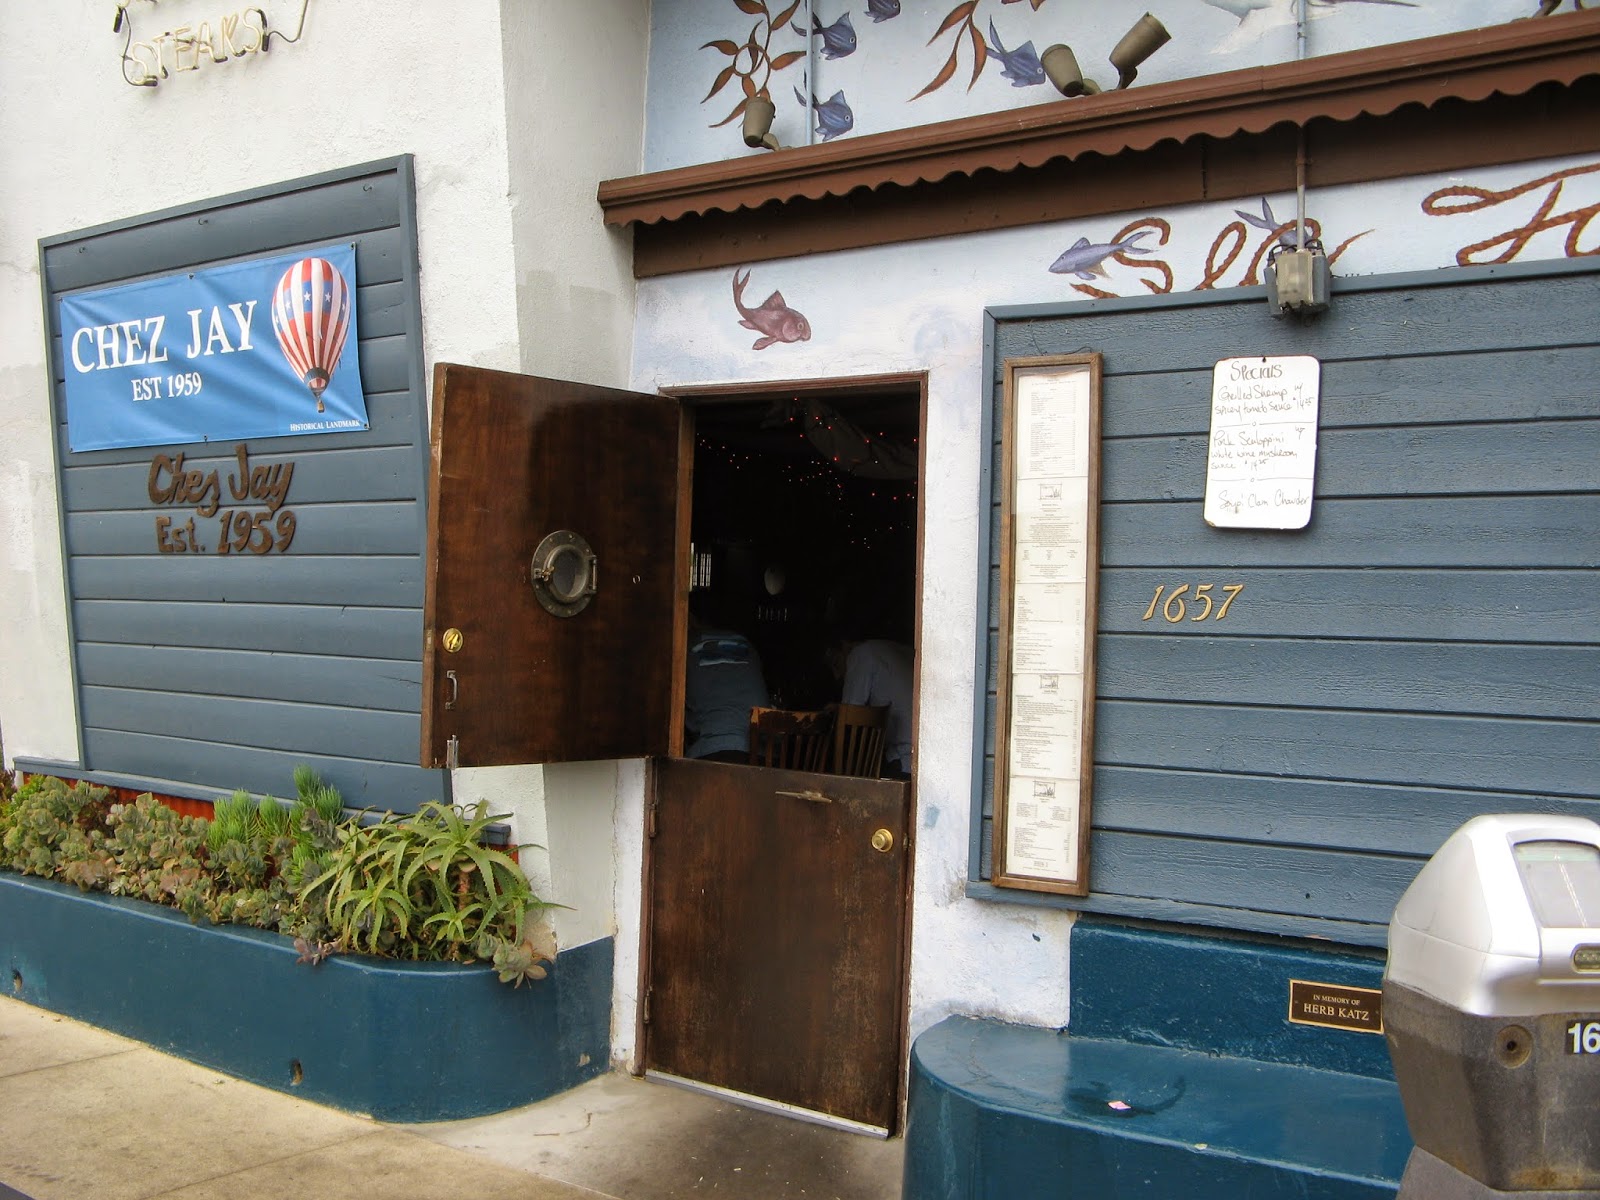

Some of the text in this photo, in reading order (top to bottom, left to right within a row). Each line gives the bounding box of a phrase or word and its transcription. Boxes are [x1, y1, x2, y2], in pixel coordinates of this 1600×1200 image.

[131, 8, 267, 86] STEAKS
[71, 300, 257, 373] CHEZ JAY
[131, 372, 203, 401] EST 1959
[290, 419, 361, 432] HISTORICAL LANDMARK
[147, 443, 294, 518] Chez Jay
[155, 510, 297, 555] Est. 1959
[1142, 583, 1244, 623] 1657
[1303, 1002, 1369, 1021] HERB KATZ
[1321, 995, 1351, 1005] MEMORY
[1567, 1021, 1600, 1055] 16
